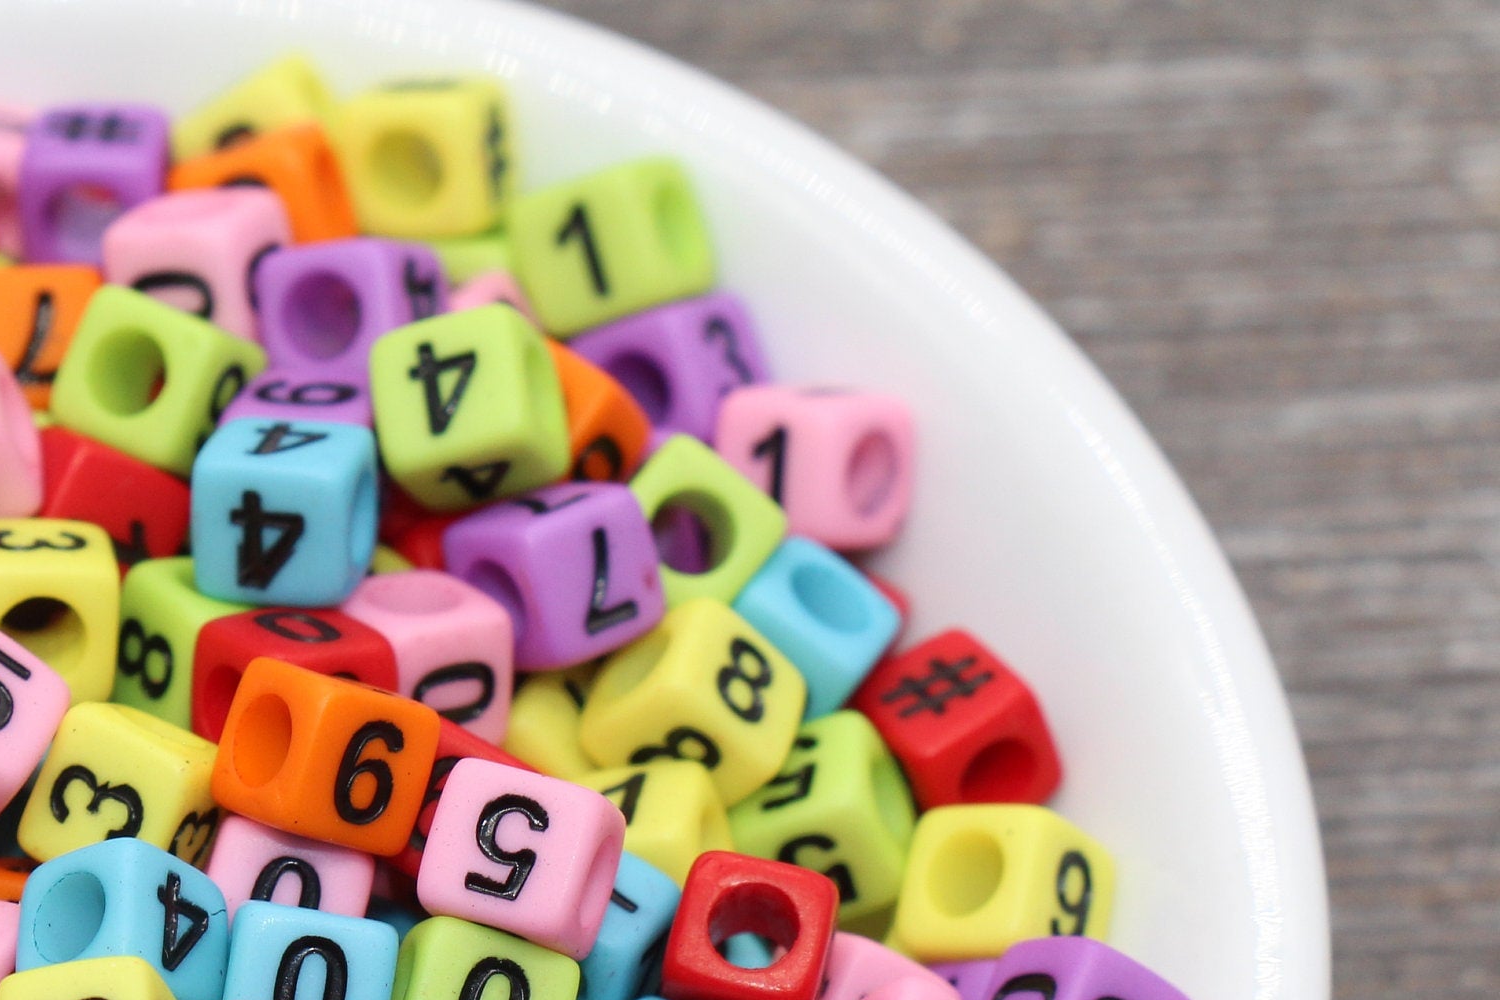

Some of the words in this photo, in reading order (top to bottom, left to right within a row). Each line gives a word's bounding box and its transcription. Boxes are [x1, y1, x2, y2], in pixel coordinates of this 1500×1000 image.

[557, 204, 609, 296] 1
[410, 343, 476, 435] 4
[248, 423, 329, 455] 4
[442, 461, 511, 500] 4
[753, 425, 788, 508] 1
[230, 490, 305, 589] 4
[585, 527, 639, 634] 7
[118, 619, 173, 699] 8
[253, 611, 342, 642] 0
[412, 661, 496, 724] 0
[716, 637, 773, 723] 8
[880, 655, 994, 718] #
[50, 764, 145, 840] 3
[333, 719, 405, 826] 6
[463, 793, 550, 901] 5
[157, 870, 210, 972] 4
[1049, 849, 1093, 938] 9
